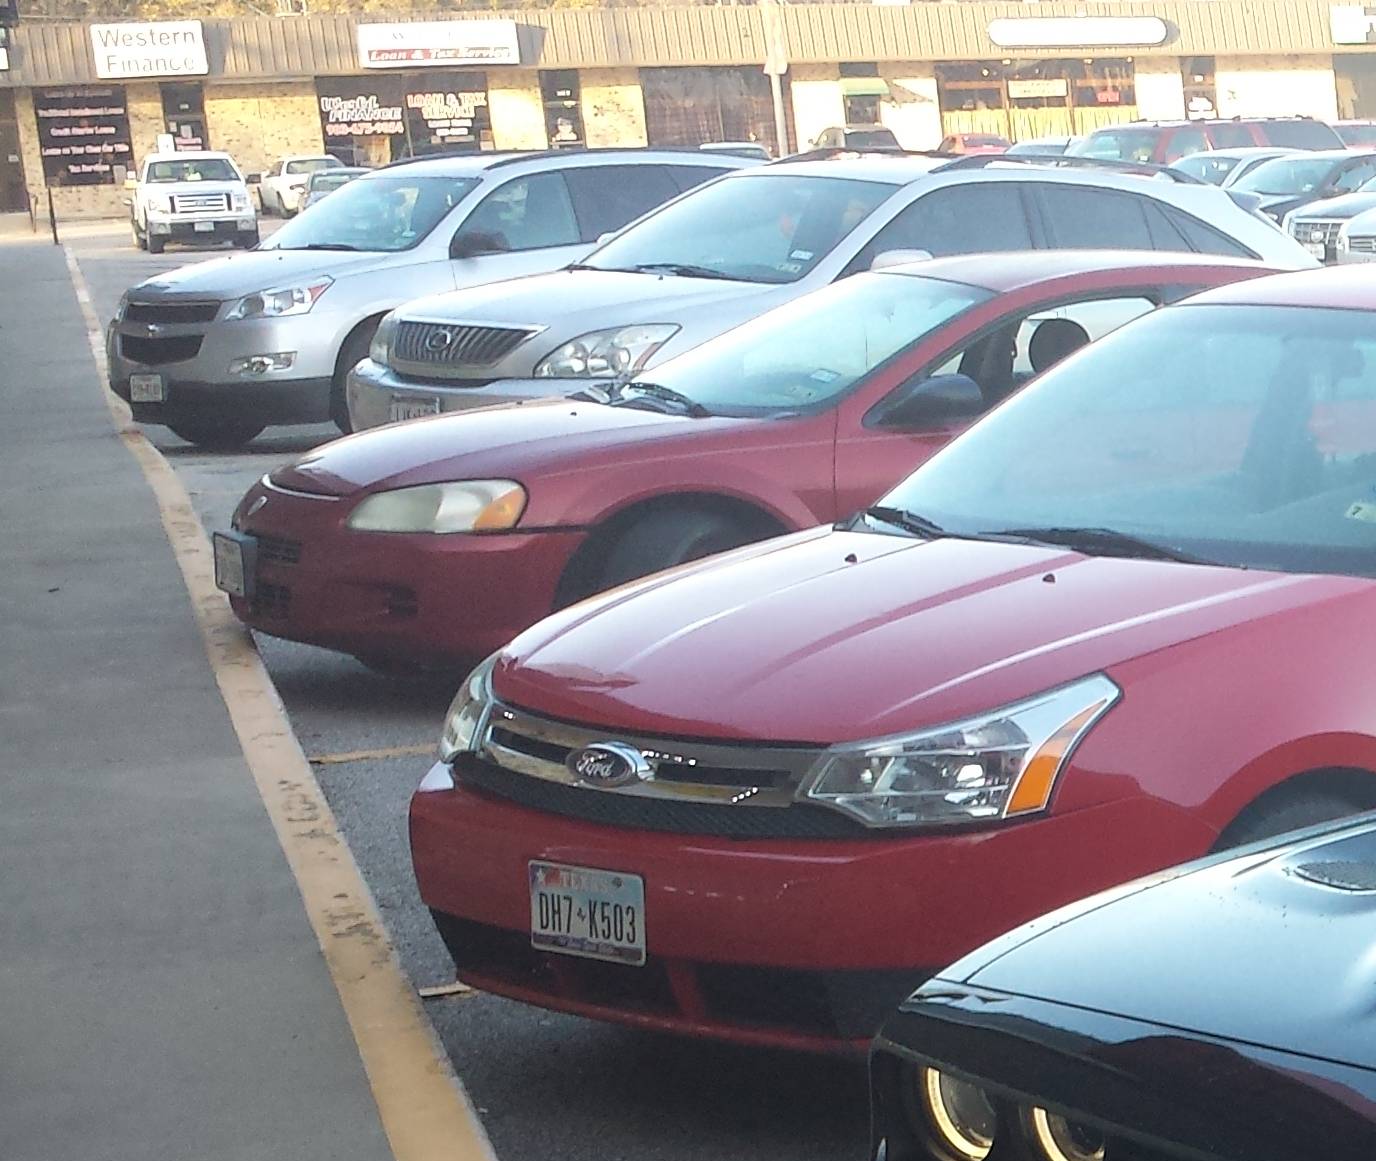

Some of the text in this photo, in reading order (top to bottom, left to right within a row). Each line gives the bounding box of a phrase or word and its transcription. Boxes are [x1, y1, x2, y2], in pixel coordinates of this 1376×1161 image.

[98, 28, 196, 47] Western
[106, 55, 195, 73] Finance
[370, 50, 407, 61] Loan
[575, 752, 615, 778] Ford
